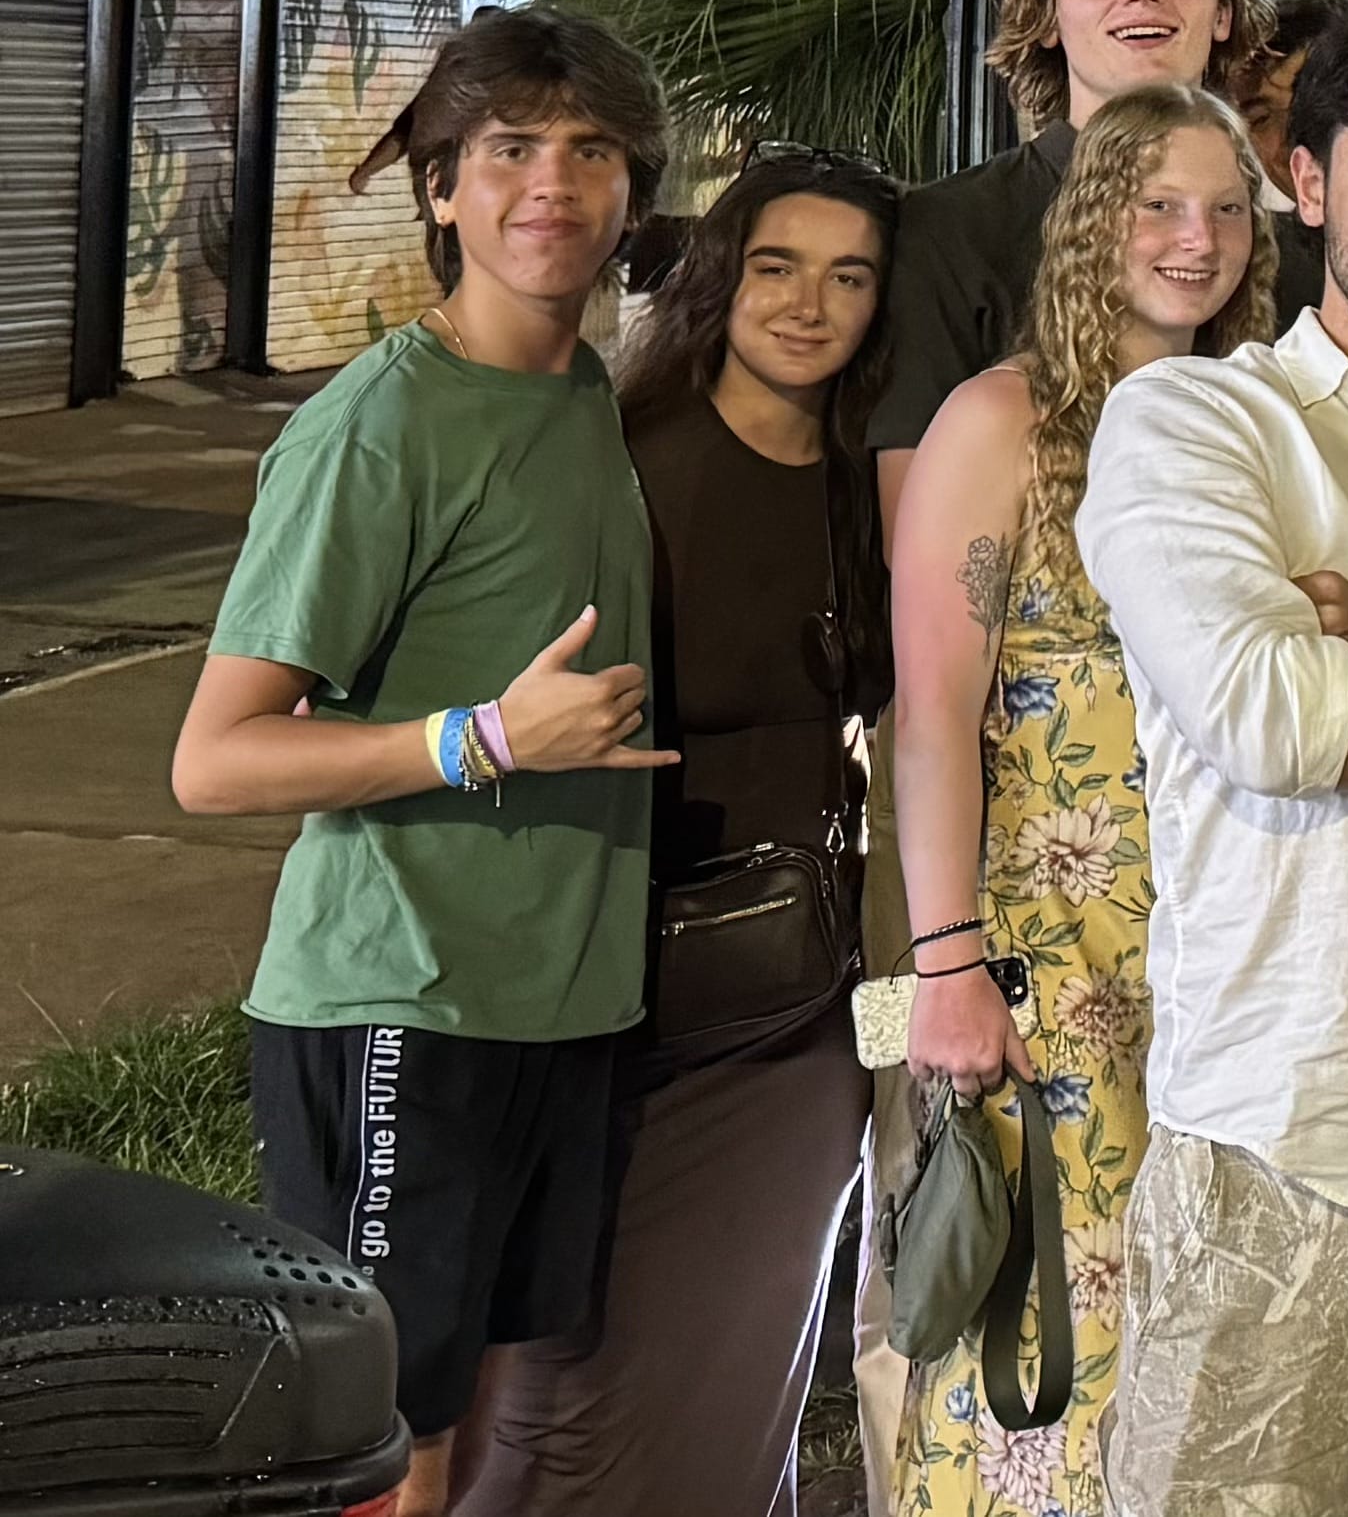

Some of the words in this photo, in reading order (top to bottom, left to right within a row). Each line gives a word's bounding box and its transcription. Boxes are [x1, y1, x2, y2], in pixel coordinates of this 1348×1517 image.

[368, 1129, 396, 1178] the
[363, 1185, 392, 1213] to
[361, 1220, 390, 1258] go
